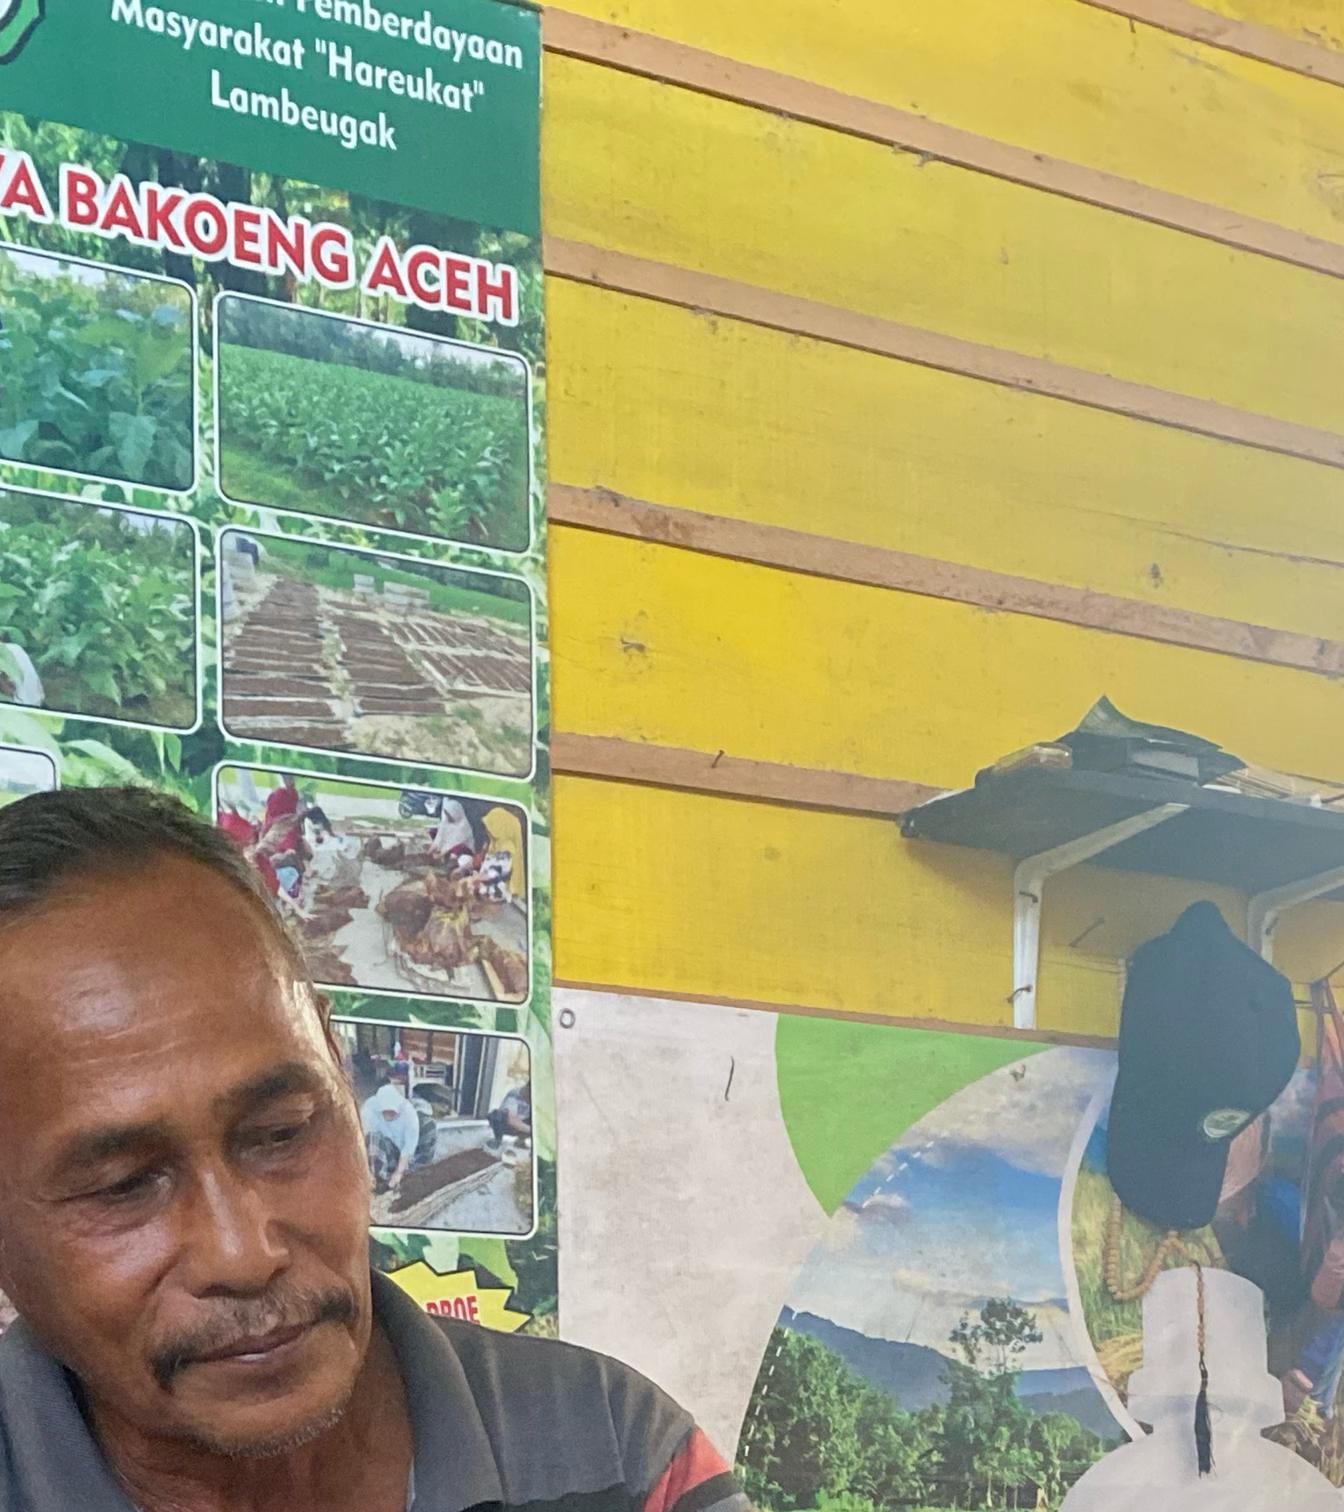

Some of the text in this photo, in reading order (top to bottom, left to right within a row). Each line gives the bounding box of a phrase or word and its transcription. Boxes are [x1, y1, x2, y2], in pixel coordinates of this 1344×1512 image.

[109, 0, 485, 113] Masyarakat "Hareukat"
[210, 68, 397, 151] Lambeugak
[65, 167, 351, 286] BAKOENG
[367, 234, 516, 321] ACEH
